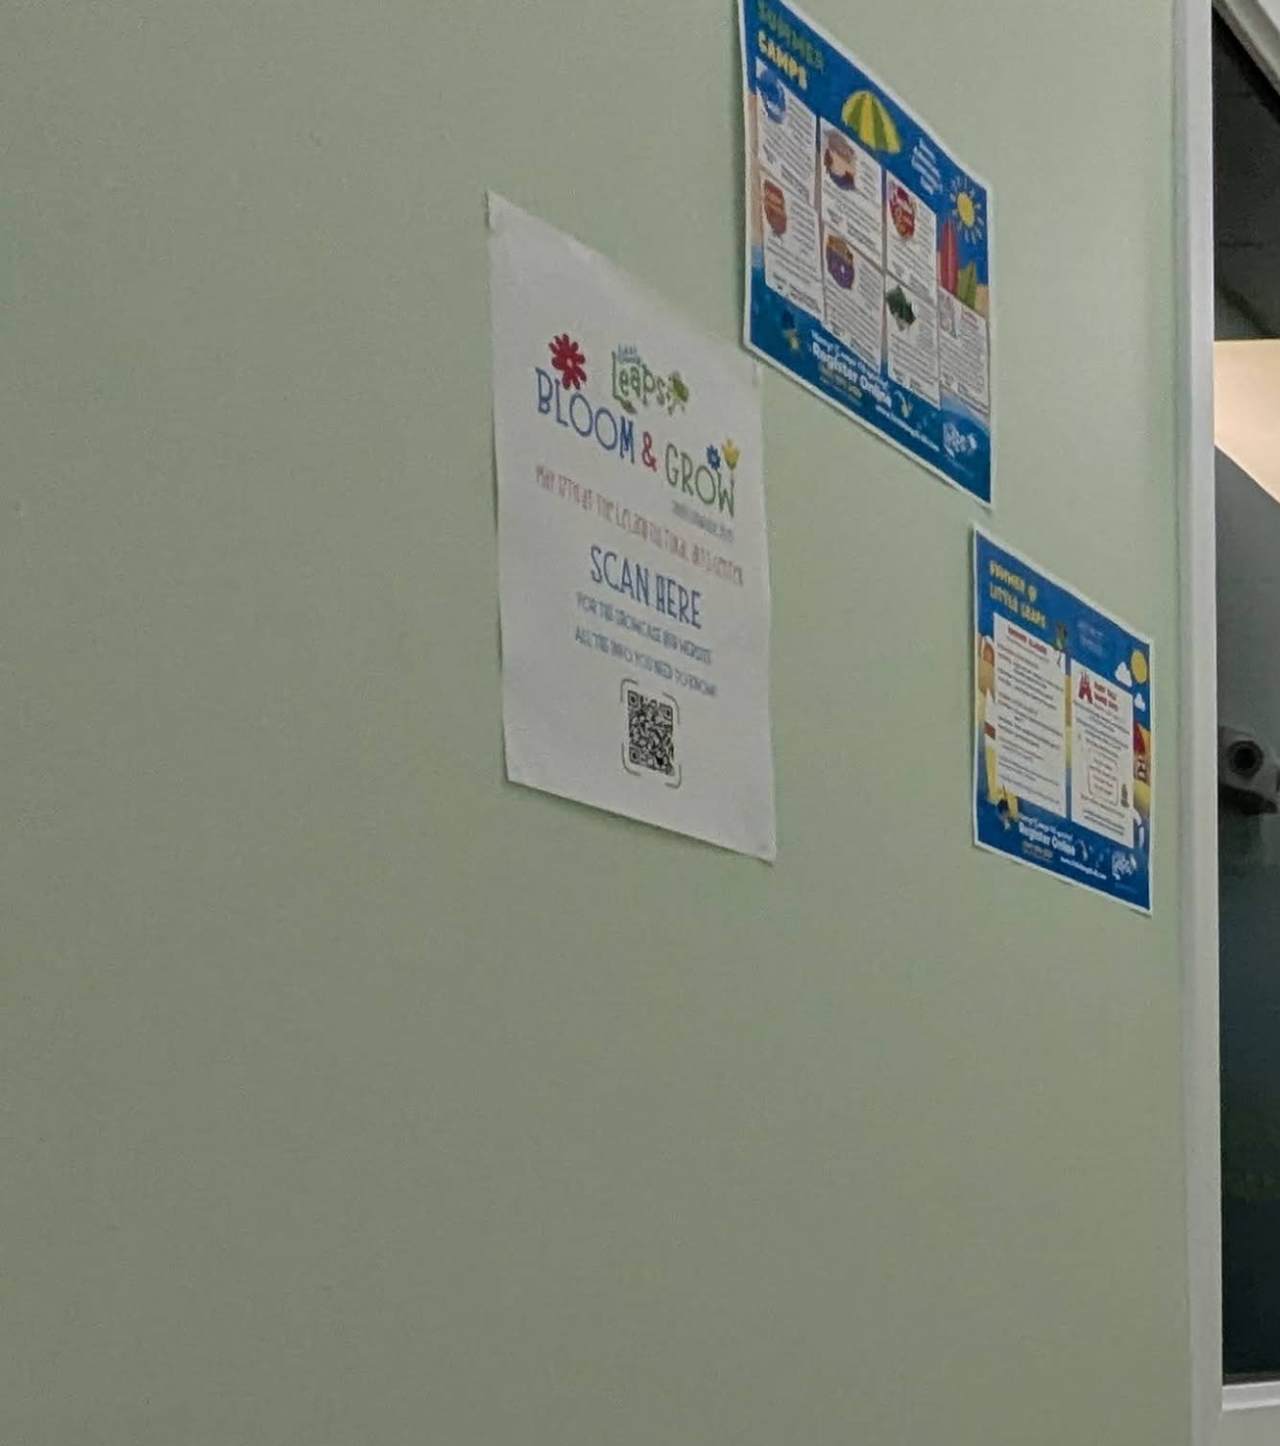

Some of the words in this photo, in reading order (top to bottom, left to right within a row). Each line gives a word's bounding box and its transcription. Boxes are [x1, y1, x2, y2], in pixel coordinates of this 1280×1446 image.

[535, 367, 635, 465] BLOOM
[641, 431, 657, 472] &
[665, 443, 735, 518] GROW
[590, 544, 650, 607] SCAN
[655, 572, 702, 630] HERE
